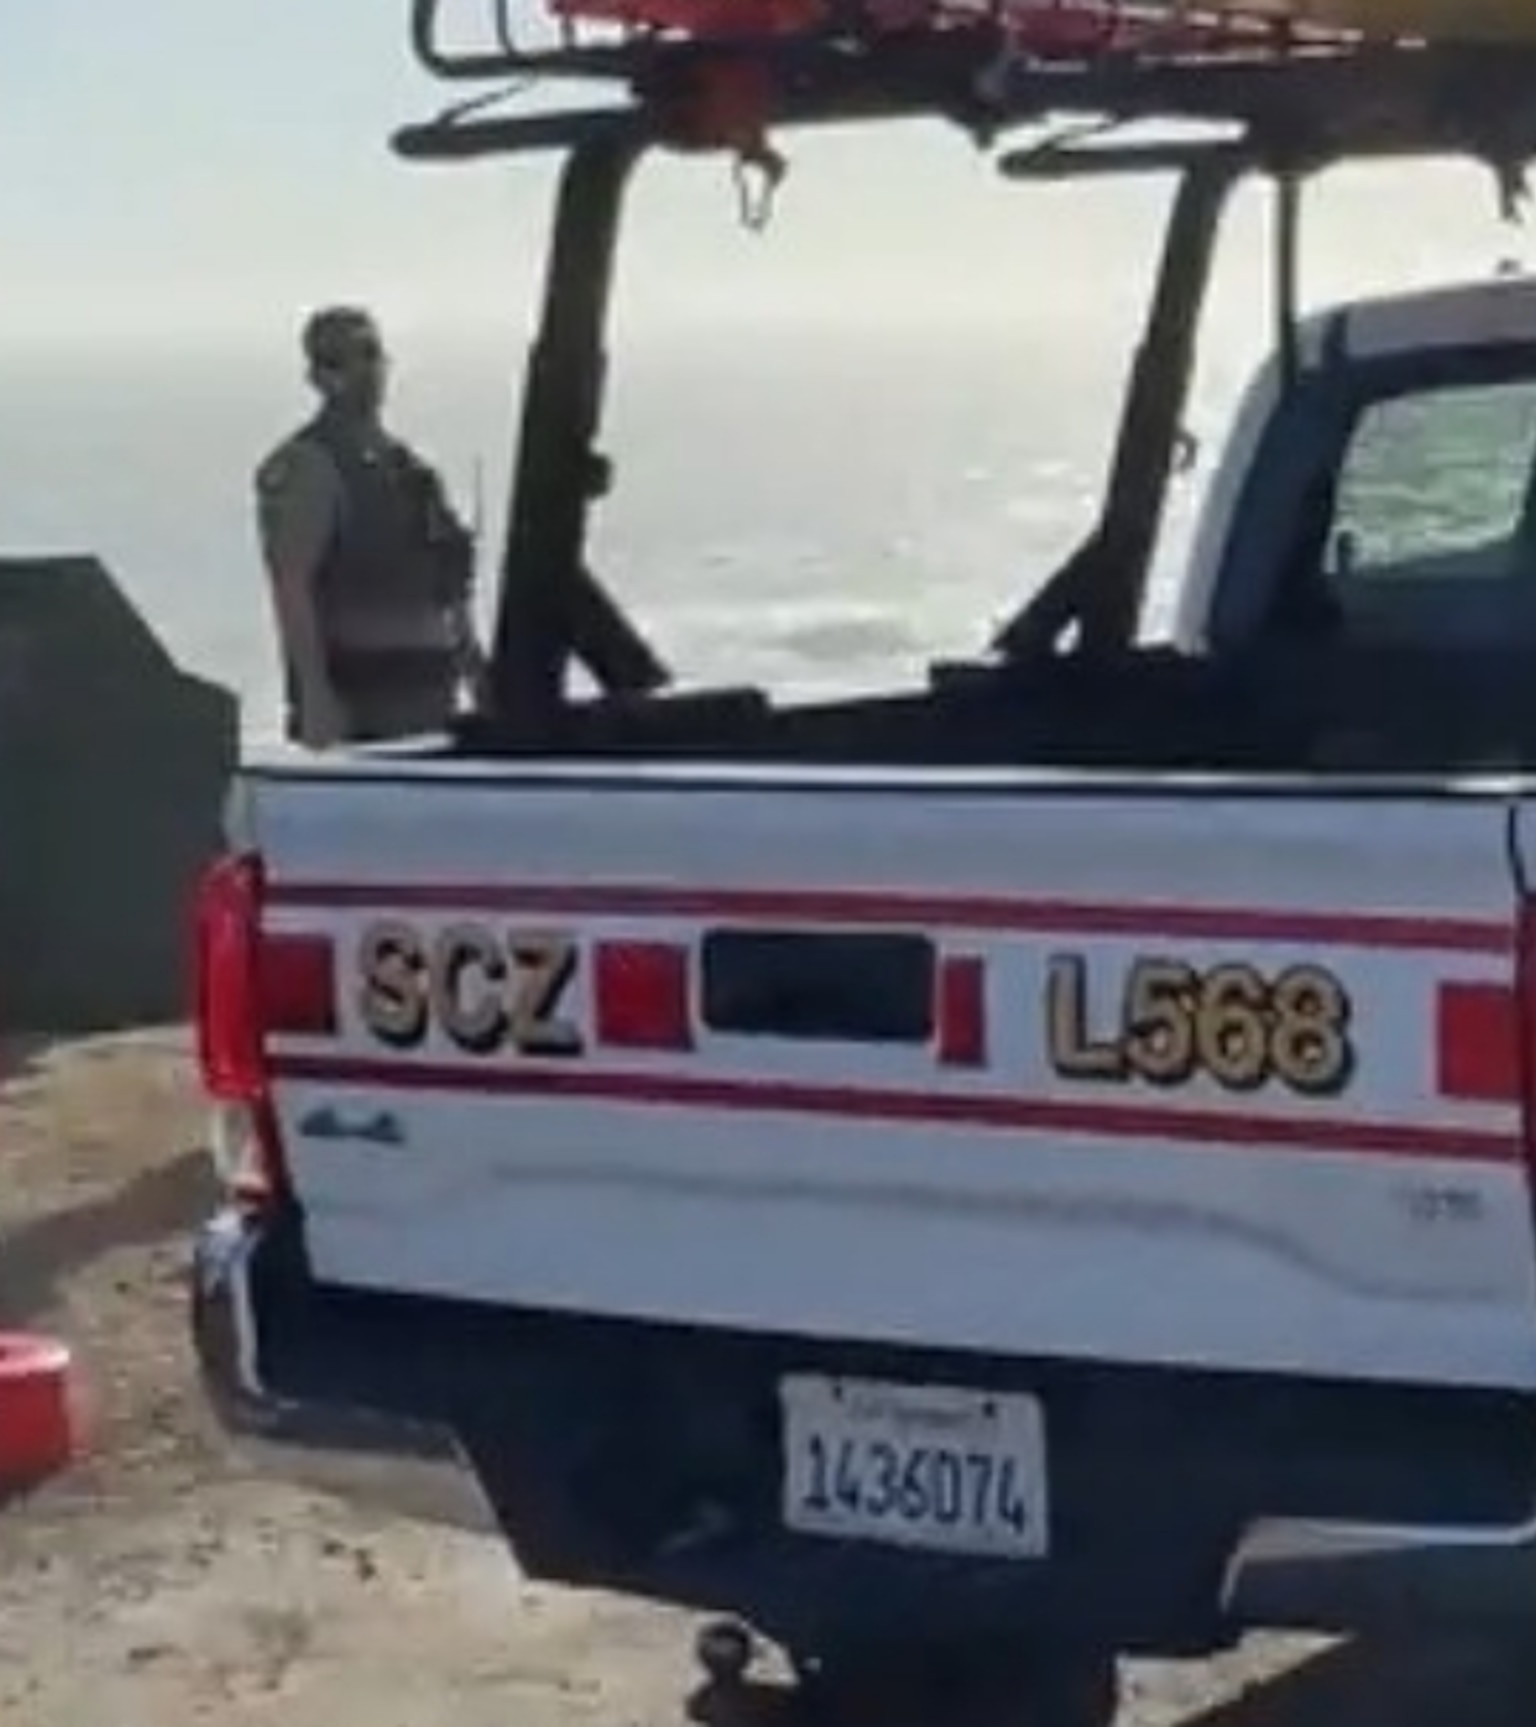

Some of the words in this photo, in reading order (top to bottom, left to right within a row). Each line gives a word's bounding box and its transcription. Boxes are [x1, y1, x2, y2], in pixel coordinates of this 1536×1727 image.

[360, 921, 586, 1058] SCZ
[1044, 949, 1356, 1097] L568
[801, 1434, 1026, 1538] 1436074
